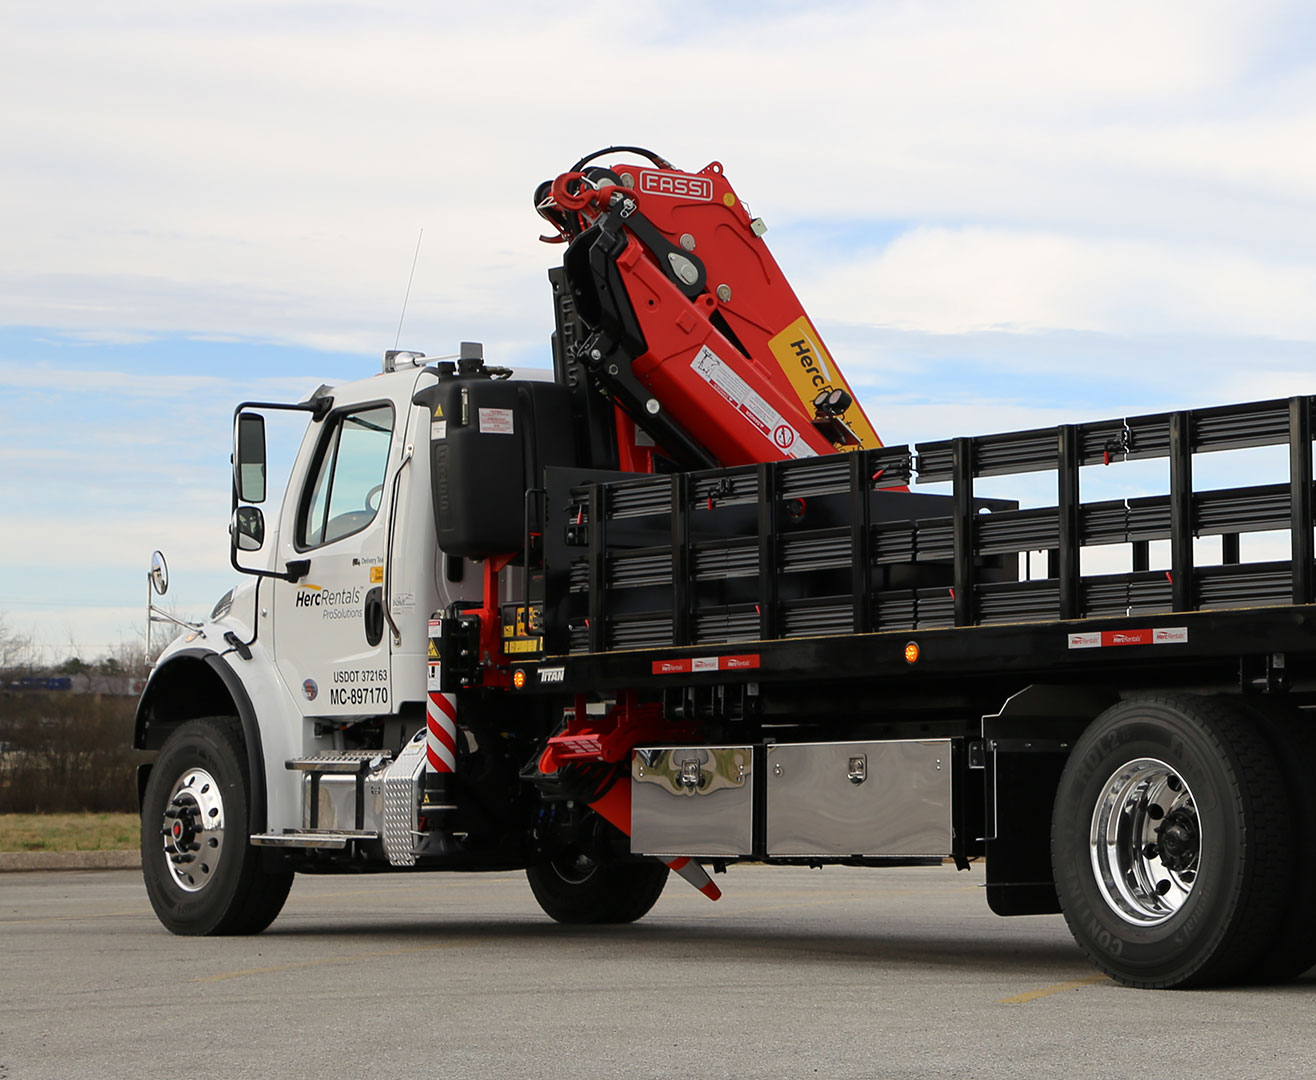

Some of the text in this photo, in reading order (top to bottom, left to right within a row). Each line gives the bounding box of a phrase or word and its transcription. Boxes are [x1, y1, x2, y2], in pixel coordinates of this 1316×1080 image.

[646, 175, 706, 196] FASSI
[296, 586, 360, 608] HercRentals
[323, 608, 363, 620] ProSolutions
[333, 670, 388, 683] USDOT 372163
[537, 666, 565, 682] TITAN
[330, 687, 388, 705] MC-897170
